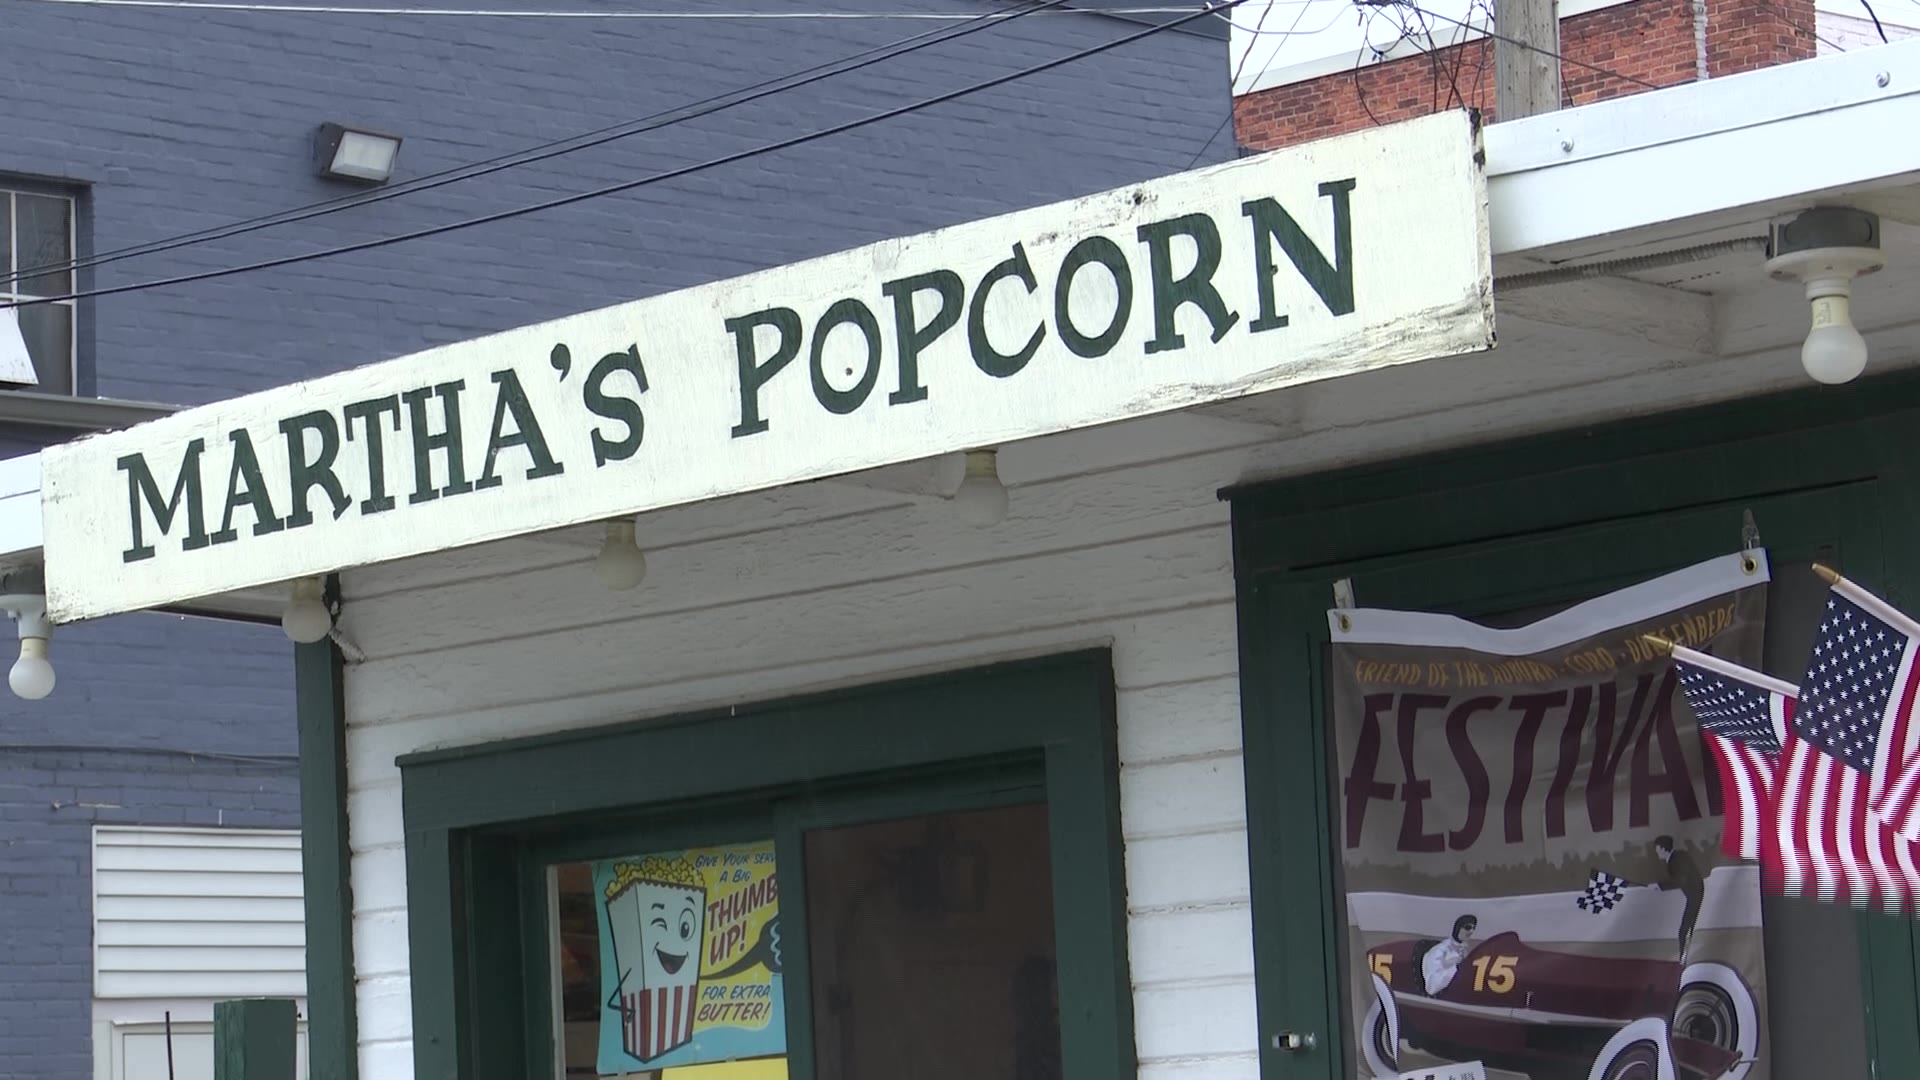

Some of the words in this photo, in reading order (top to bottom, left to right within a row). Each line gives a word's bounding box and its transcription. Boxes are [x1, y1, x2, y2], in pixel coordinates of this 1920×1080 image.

[117, 342, 650, 564] MARTHA'S
[725, 177, 1357, 439] POPCORN
[1355, 658, 1421, 685] FRIEND
[1428, 662, 1448, 688] OF
[1457, 660, 1488, 687] THE
[695, 854, 719, 868] GIVE
[723, 852, 750, 866] YOUR
[719, 870, 729, 883] A
[732, 869, 751, 883] BIG
[710, 919, 747, 967] UP!
[1472, 955, 1519, 994] 15
[702, 986, 727, 999] FOR
[731, 984, 770, 998] EXTRA
[697, 1002, 770, 1021] BUTTER!
